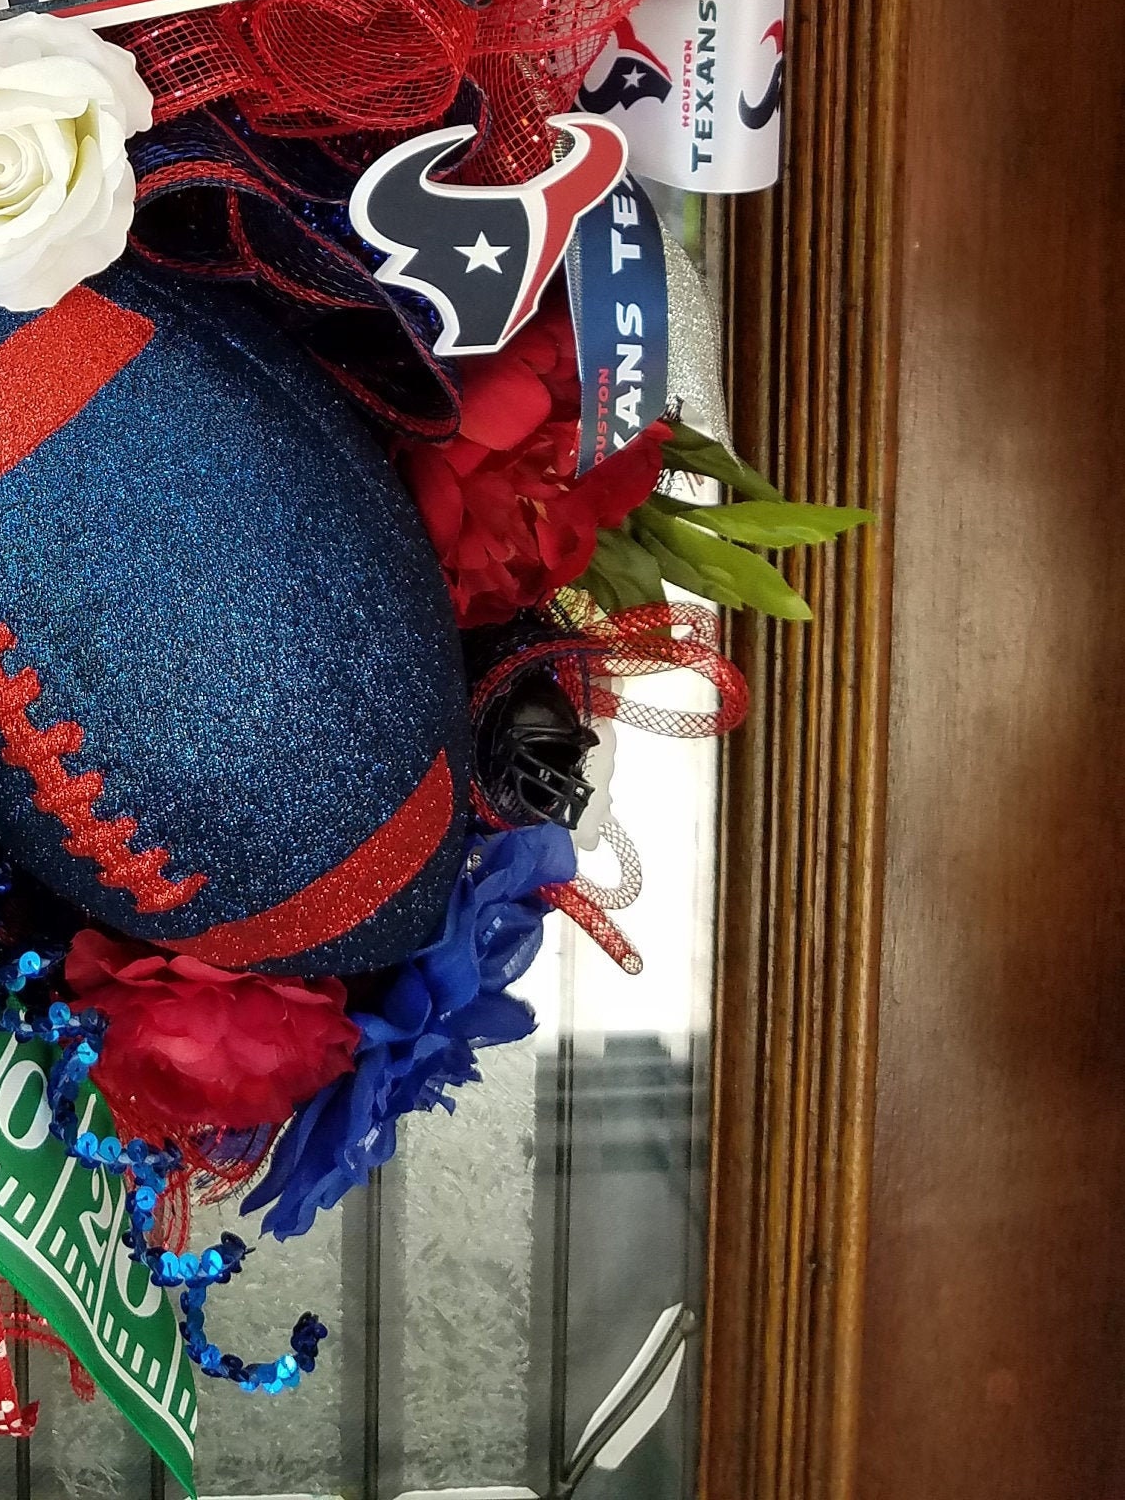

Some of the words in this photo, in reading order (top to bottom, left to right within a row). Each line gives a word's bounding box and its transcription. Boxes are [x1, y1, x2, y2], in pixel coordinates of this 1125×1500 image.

[682, 39, 693, 128] HOUSTON
[691, 0, 717, 173] TEXANS
[594, 367, 610, 466] OUSTON
